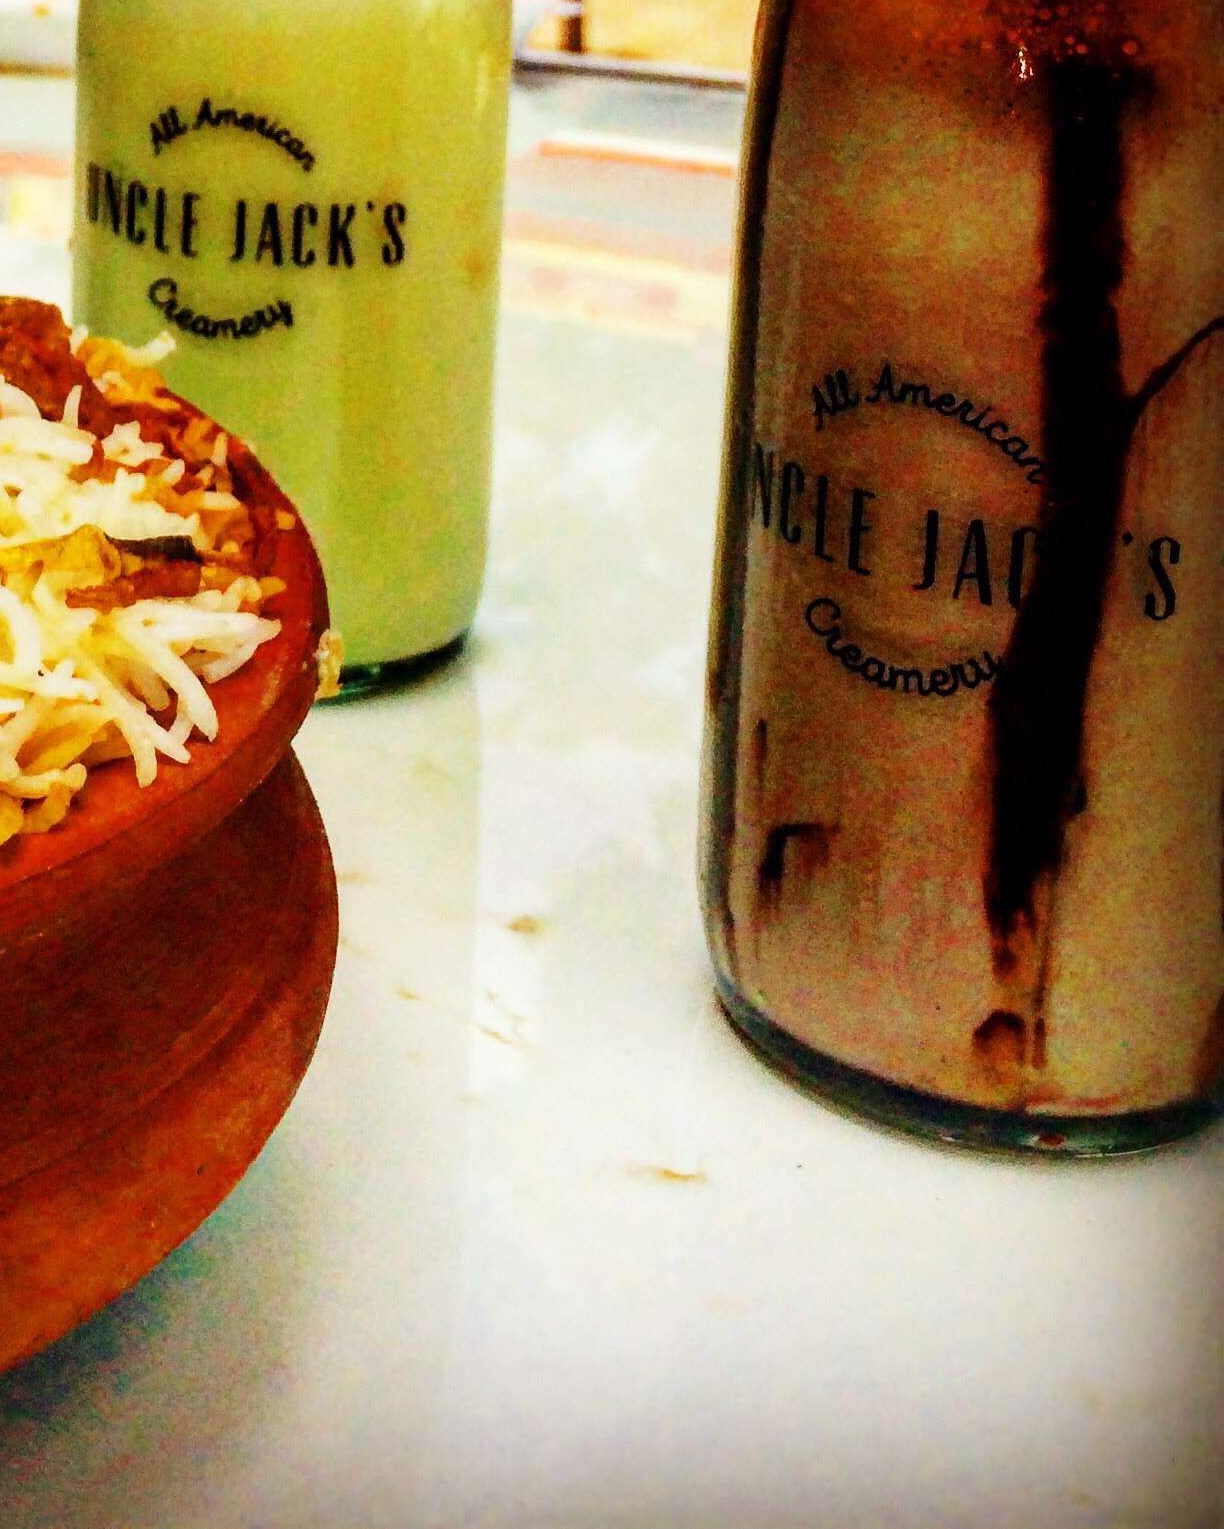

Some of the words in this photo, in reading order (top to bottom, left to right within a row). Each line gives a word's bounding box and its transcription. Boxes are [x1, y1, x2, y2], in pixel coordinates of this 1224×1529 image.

[149, 107, 187, 157] All
[193, 98, 316, 172] American
[230, 198, 407, 268] JACK'S
[147, 276, 295, 340] Creamery
[812, 369, 857, 432] All
[865, 363, 1049, 485] American
[750, 441, 876, 577] NCLE
